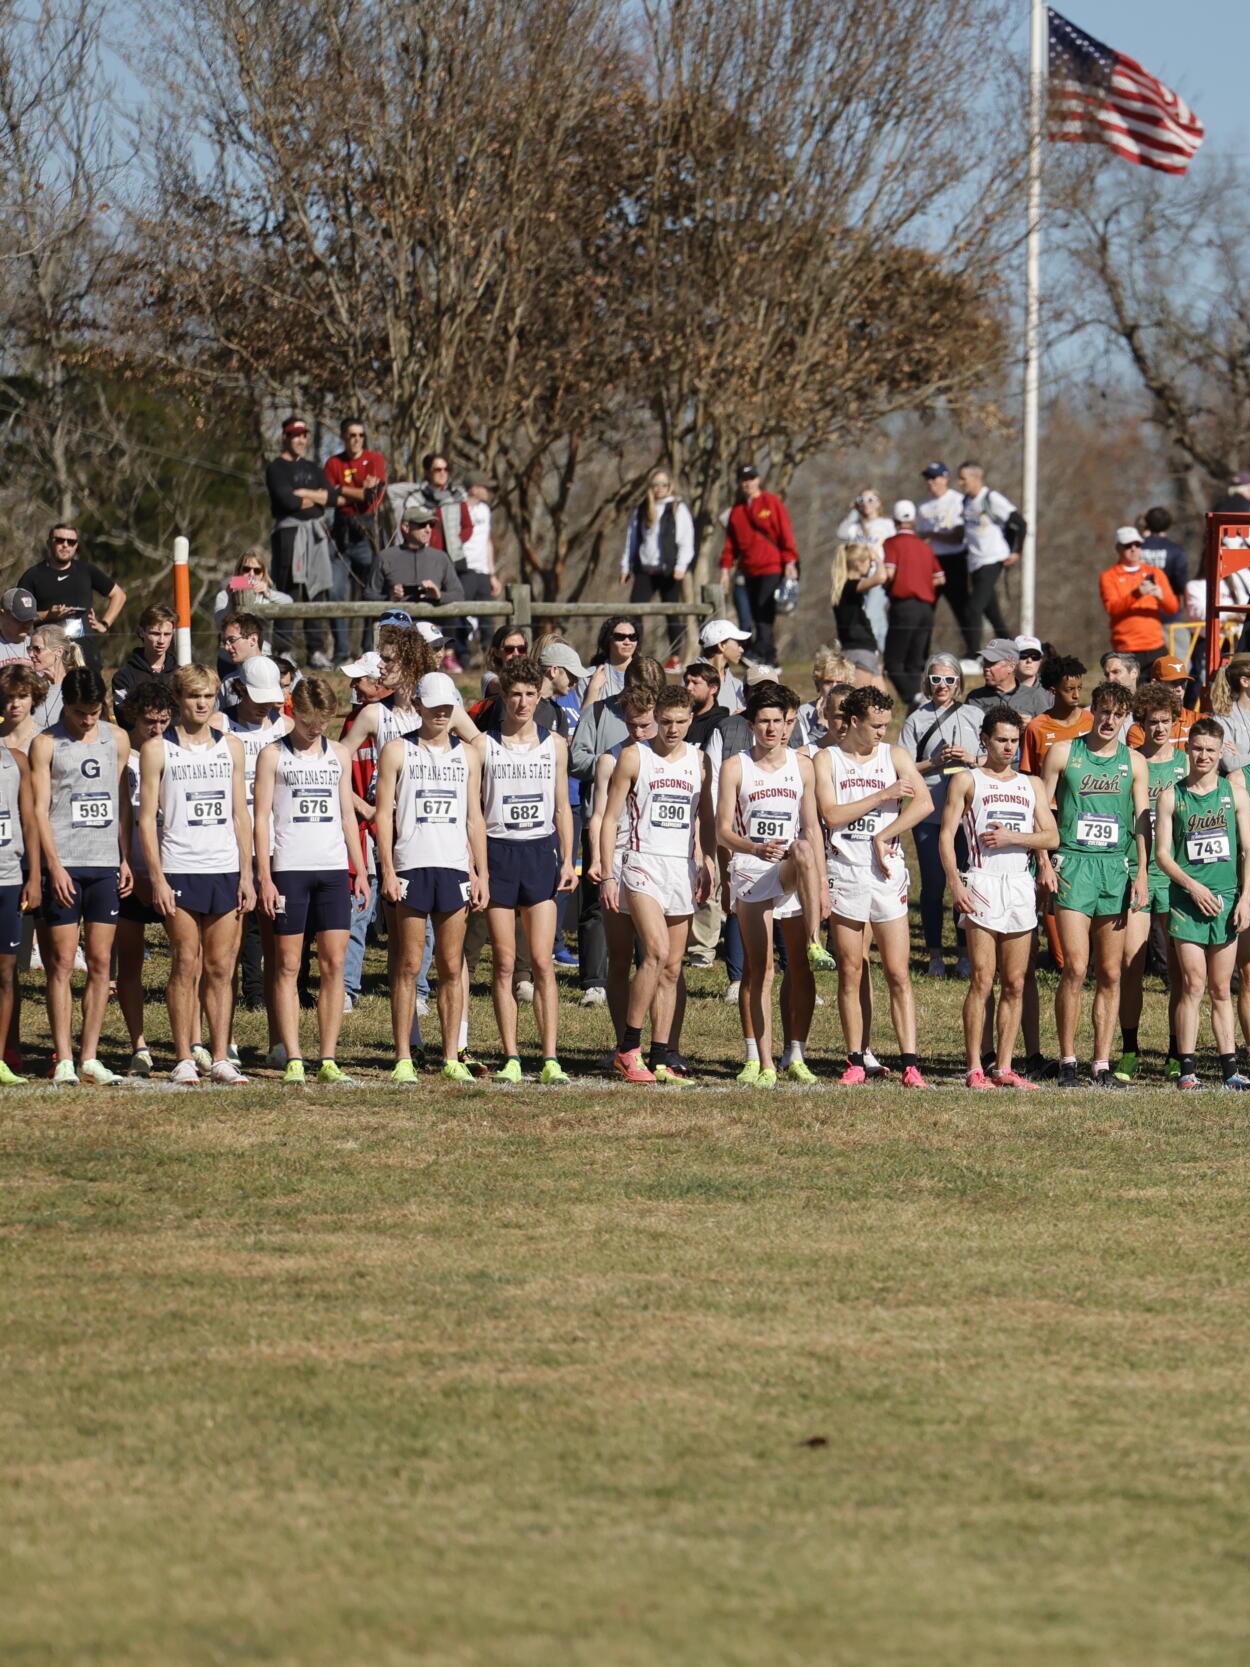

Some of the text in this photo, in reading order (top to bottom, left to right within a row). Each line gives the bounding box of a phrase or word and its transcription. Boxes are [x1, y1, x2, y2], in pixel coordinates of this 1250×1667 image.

[80, 758, 101, 779] G
[170, 762, 231, 781] MONTANA STATE
[408, 764, 465, 783] MONTANA STATE
[491, 763, 552, 780] MONTANA STATE
[282, 769, 340, 787] MONTANA STATE
[648, 778, 695, 793] WISCONSIN
[839, 778, 886, 790] WISCONSIN
[1080, 773, 1121, 791] Irish
[748, 787, 798, 803] WISCONSIN
[982, 793, 1030, 808] WISCONSIN
[79, 803, 108, 818] 593
[193, 801, 223, 818] 678
[299, 799, 328, 815] 676
[423, 800, 452, 815] 677
[510, 804, 539, 821] 682
[658, 804, 685, 821] 890
[847, 818, 875, 833] 896
[1186, 807, 1228, 832] Irish
[756, 821, 784, 837] 891
[1084, 823, 1112, 839] 739
[1194, 840, 1223, 857] 743
